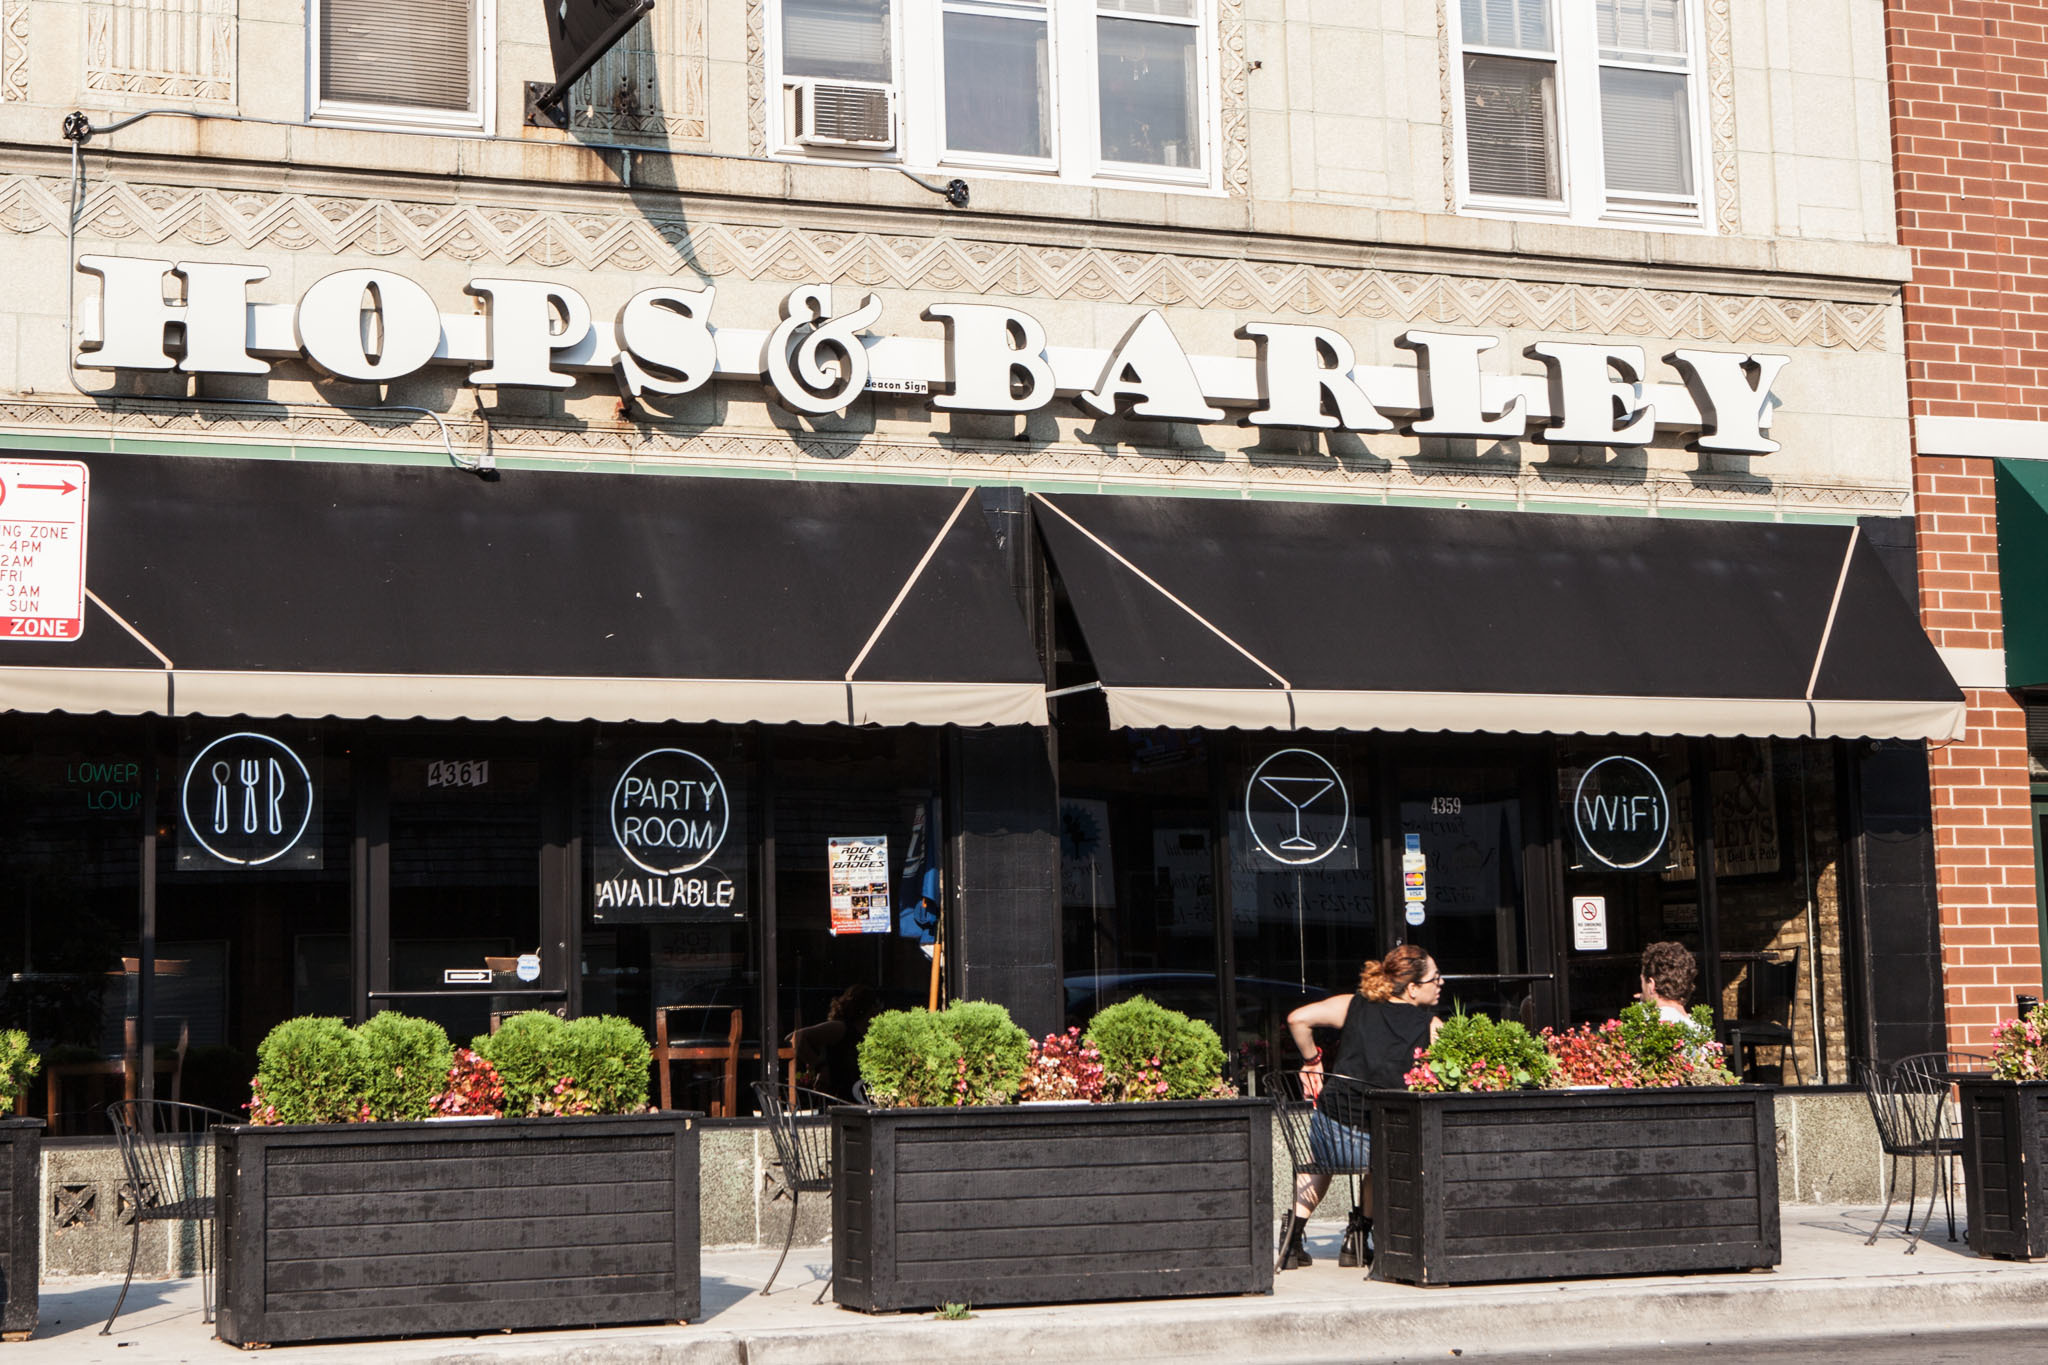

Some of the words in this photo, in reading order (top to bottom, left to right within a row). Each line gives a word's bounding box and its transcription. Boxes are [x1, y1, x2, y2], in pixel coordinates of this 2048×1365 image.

[74, 253, 716, 397] HOPS
[759, 283, 883, 416] &
[920, 302, 1792, 457] BARLEY
[865, 378, 901, 390] Beacon
[905, 381, 927, 393] Sign
[30, 526, 69, 540] ZONE
[0, 569, 23, 583] FRI
[9, 599, 39, 613] SUN
[10, 618, 69, 637] ZONE
[429, 762, 484, 785] 4361
[623, 777, 717, 812] PARTY
[1430, 797, 1461, 814] 4359
[1583, 794, 1659, 832] WiFi
[623, 816, 713, 850] ROOM
[841, 846, 876, 854] ROCK
[847, 853, 873, 861] THE
[832, 860, 886, 869] BADGES
[597, 877, 733, 907] AVAILABLE
